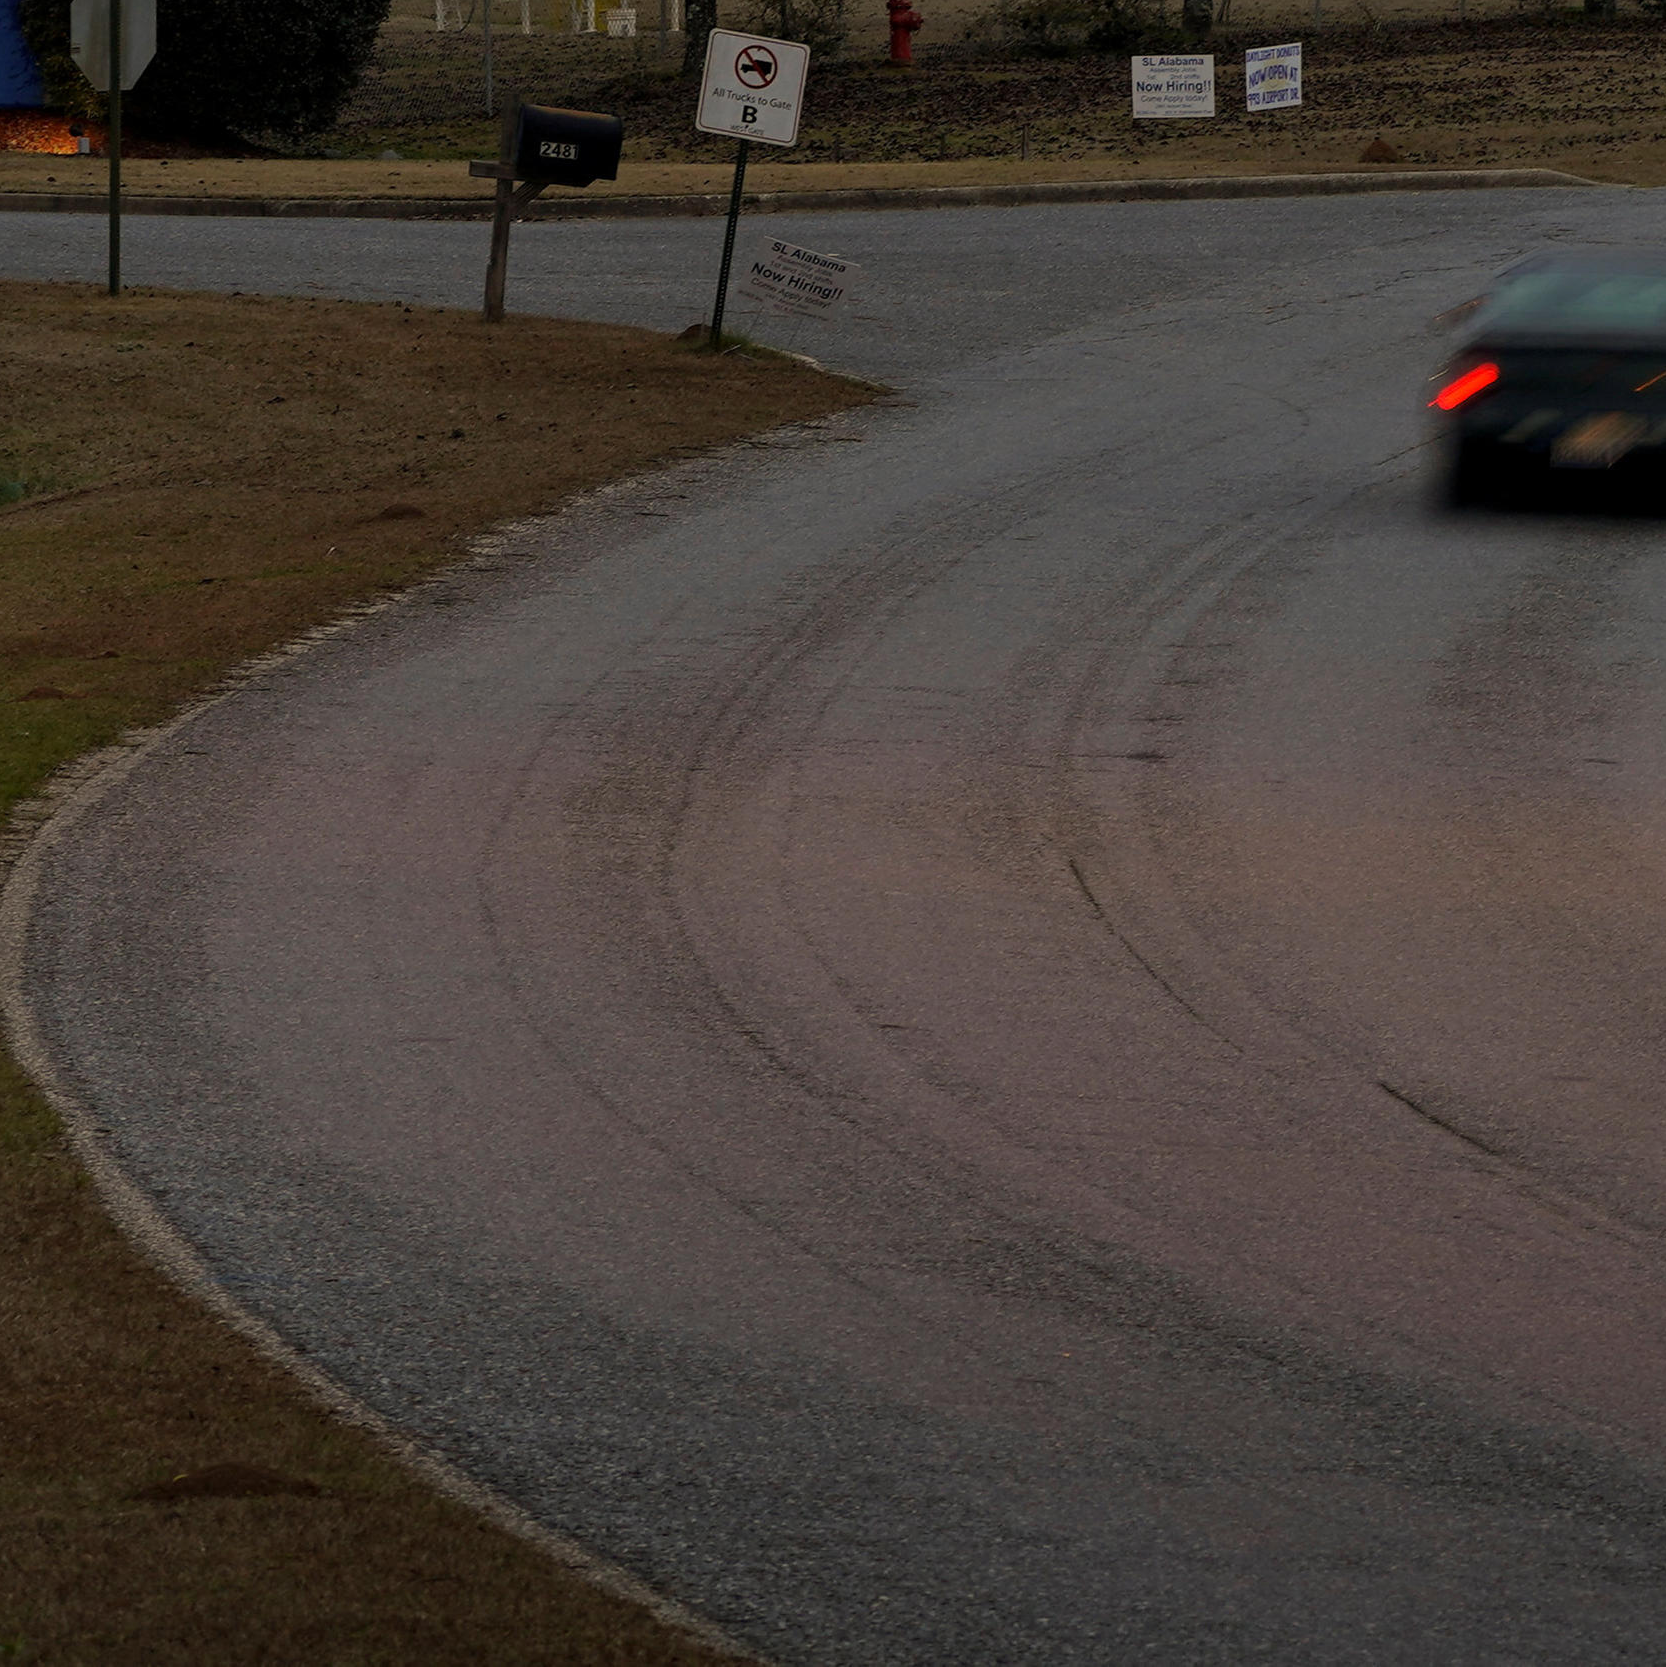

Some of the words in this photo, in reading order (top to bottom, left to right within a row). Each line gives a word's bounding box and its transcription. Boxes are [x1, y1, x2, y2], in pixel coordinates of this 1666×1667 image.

[1141, 57, 1156, 67] SL
[1158, 57, 1205, 67] Alabama
[1246, 49, 1275, 62] DAYLIGHT
[1276, 45, 1300, 58] DONUTS
[1249, 67, 1267, 89] NOW
[1268, 64, 1288, 80] OPEN
[1289, 66, 1298, 82] AT
[1136, 81, 1163, 92] Now
[1166, 80, 1211, 93] Hiring!!
[713, 87, 725, 97] All
[726, 90, 756, 104] Trucks
[758, 97, 768, 106] to
[769, 98, 792, 110] Gate
[1163, 95, 1184, 103] Apply
[1261, 89, 1289, 104] AIRPORT
[741, 105, 758, 123] B
[541, 142, 578, 159] 2481
[771, 242, 788, 255] SL
[790, 249, 846, 273] Alabama
[750, 262, 786, 283] Now
[787, 275, 844, 300] Hiring!!
[778, 288, 805, 303] Apply
